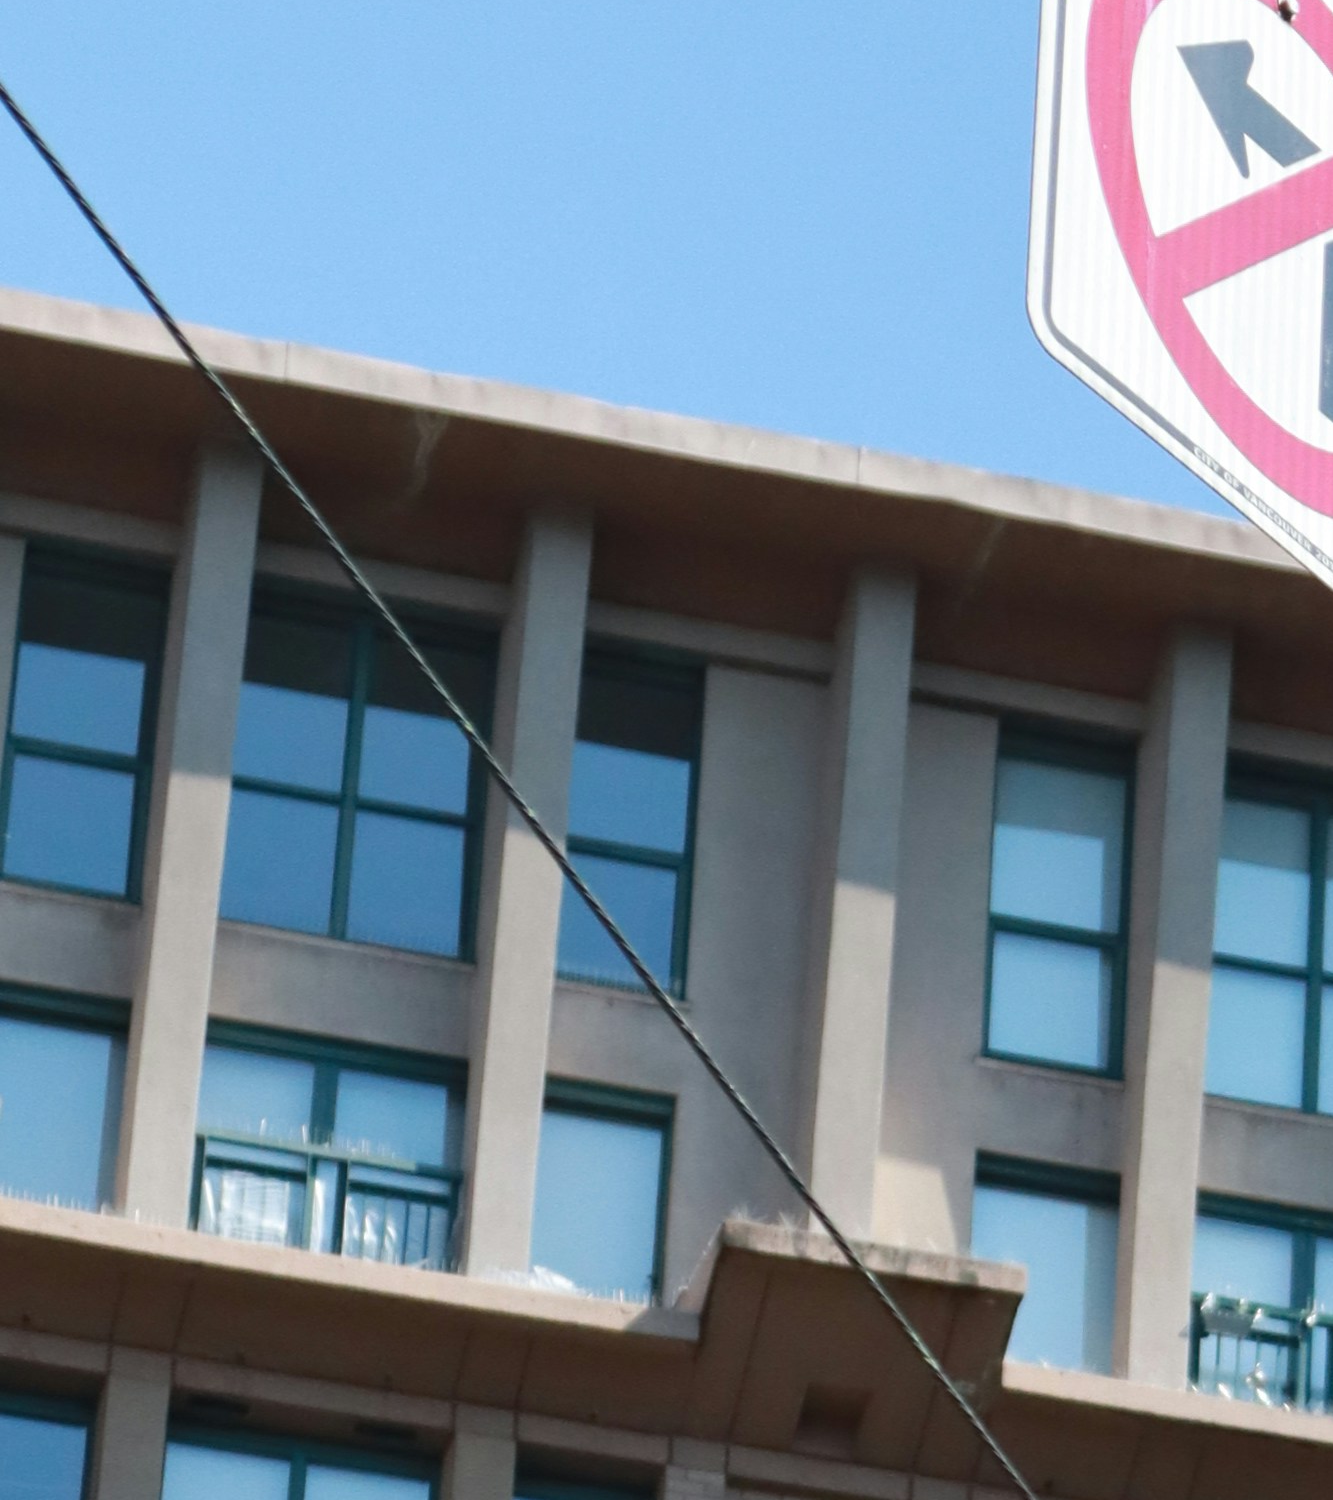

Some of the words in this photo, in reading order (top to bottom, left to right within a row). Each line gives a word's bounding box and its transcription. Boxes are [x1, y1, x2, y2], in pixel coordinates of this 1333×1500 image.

[1193, 446, 1219, 473] CITY
[1223, 471, 1239, 488] OF
[1242, 486, 1312, 553] VANCOUVER
